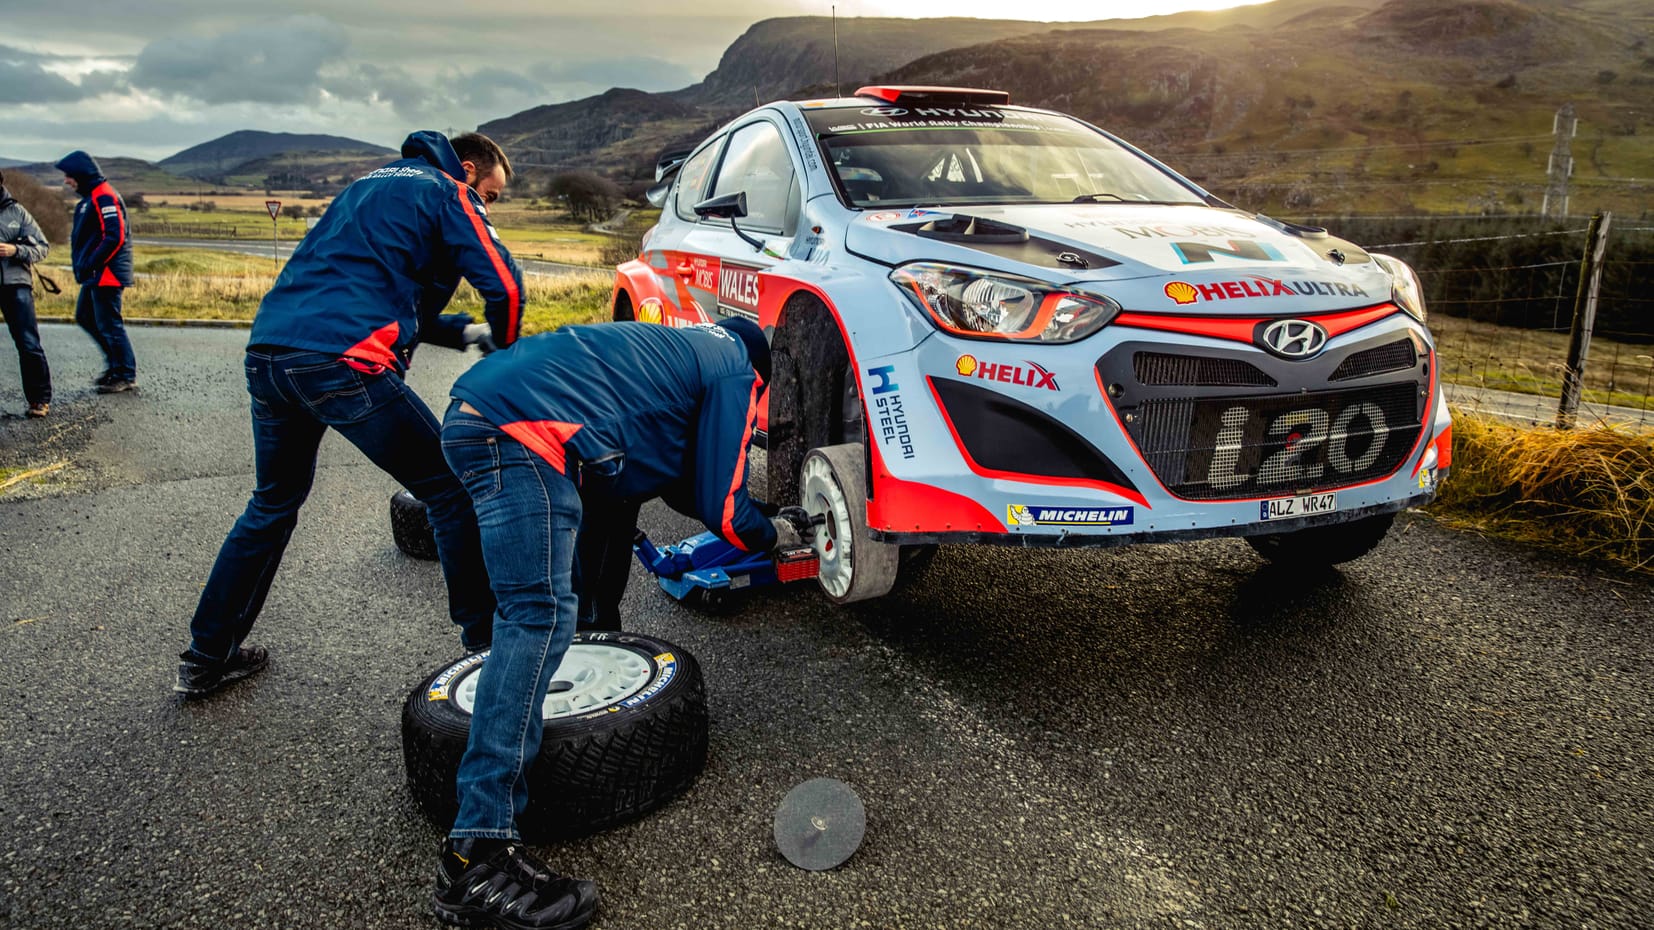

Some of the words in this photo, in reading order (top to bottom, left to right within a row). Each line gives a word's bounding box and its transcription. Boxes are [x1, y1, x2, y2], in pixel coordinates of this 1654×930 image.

[889, 120, 926, 128] World
[928, 120, 958, 128] Rally
[1113, 225, 1256, 239] MOBIS
[721, 268, 759, 306] WALES
[1197, 274, 1297, 301] HELIX
[1293, 281, 1369, 298] ULTRA
[978, 360, 1060, 392] HELIX
[875, 397, 896, 445] STEEL
[890, 395, 915, 460] HYUNDAI
[1038, 510, 1128, 521] MICHELIN
[1269, 500, 1294, 517] ALZ
[627, 667, 673, 706] MICHELIN
